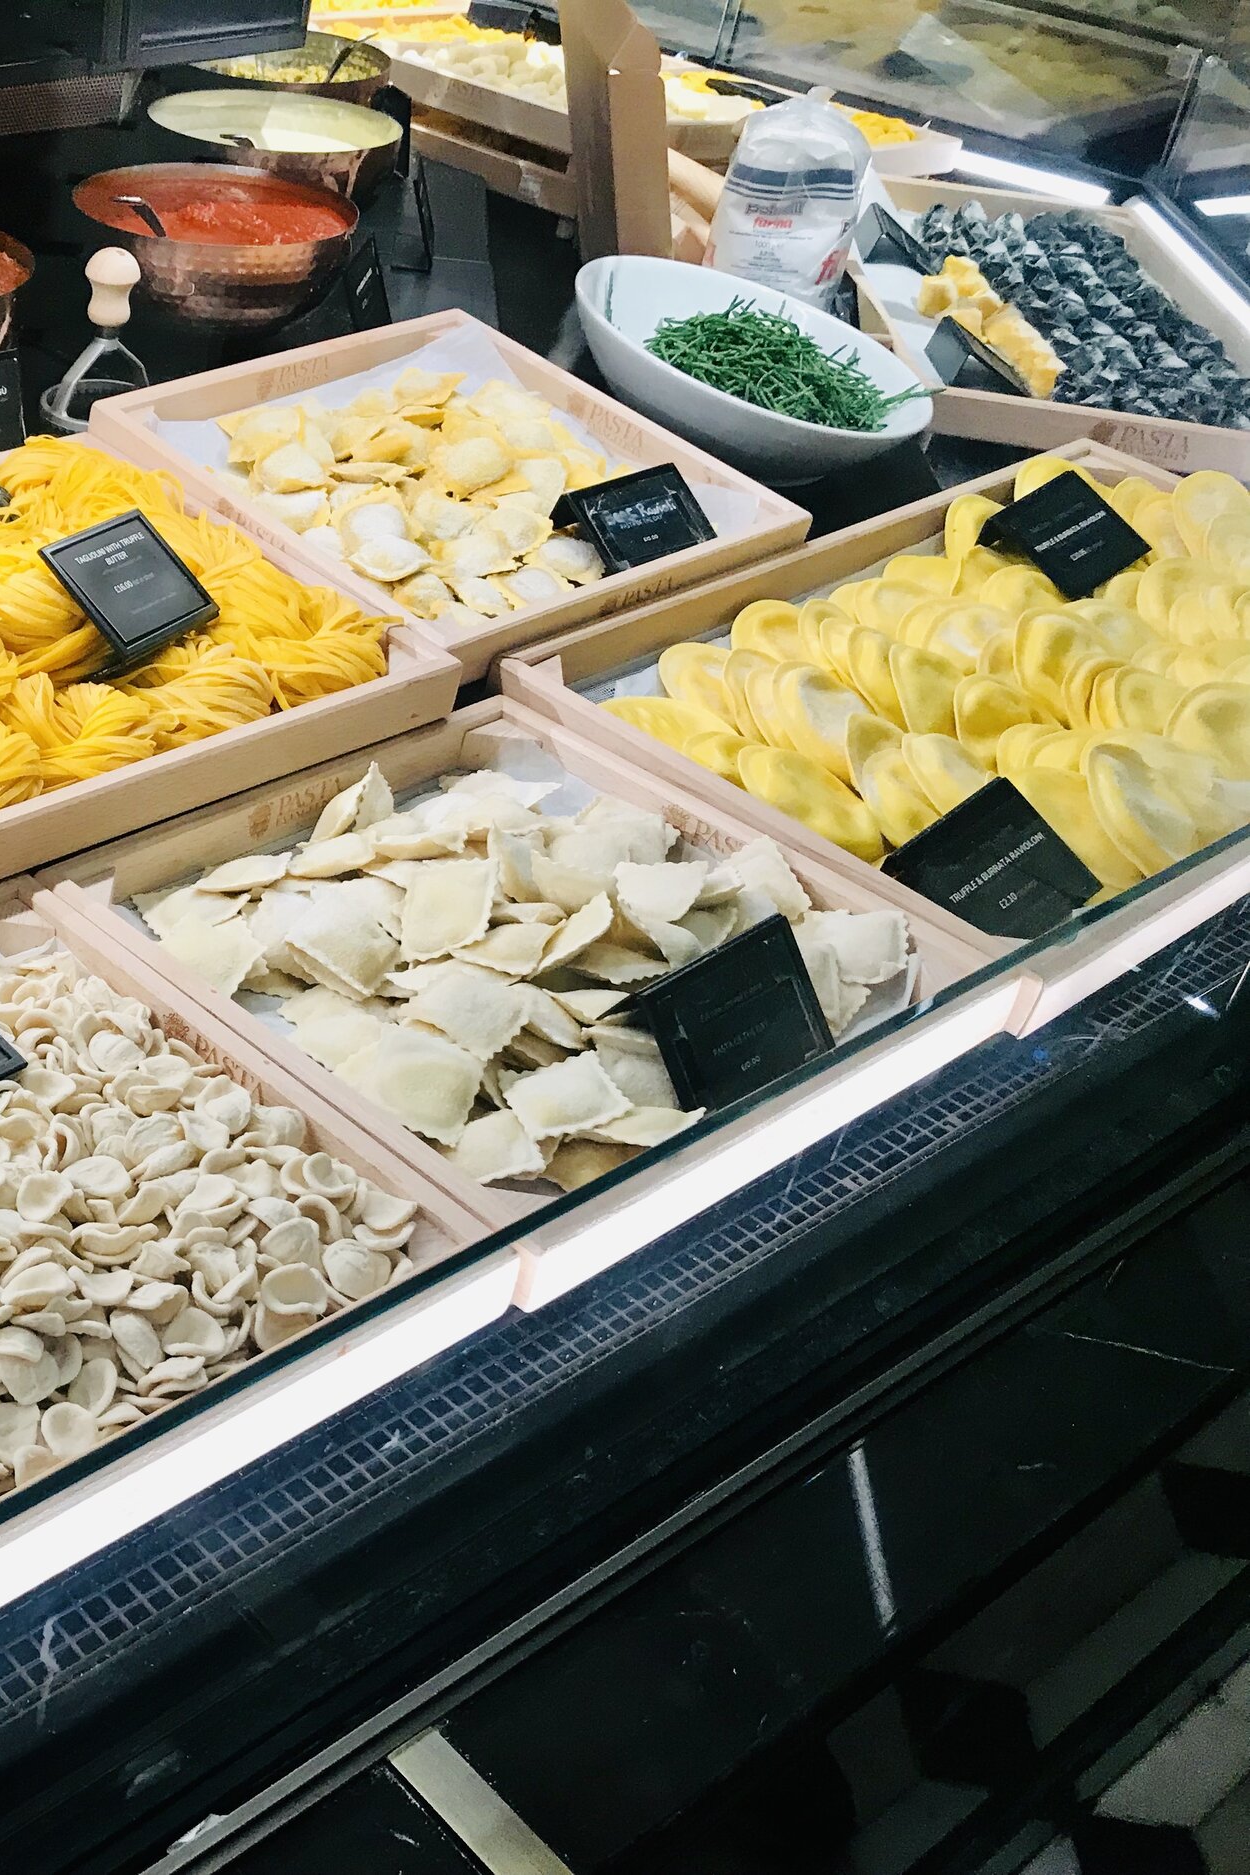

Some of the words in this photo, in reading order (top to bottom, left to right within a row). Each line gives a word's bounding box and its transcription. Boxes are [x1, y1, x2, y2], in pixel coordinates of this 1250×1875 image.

[106, 540, 122, 553] WITH
[121, 531, 145, 547] TRUFFLE
[105, 550, 129, 566] BUTTER
[1008, 831, 1045, 862] RAVIOLONI
[980, 857, 1012, 882] BURRATA
[977, 876, 984, 886] &
[949, 881, 979, 905] TRUFFLE
[998, 892, 1018, 910] £2.10
